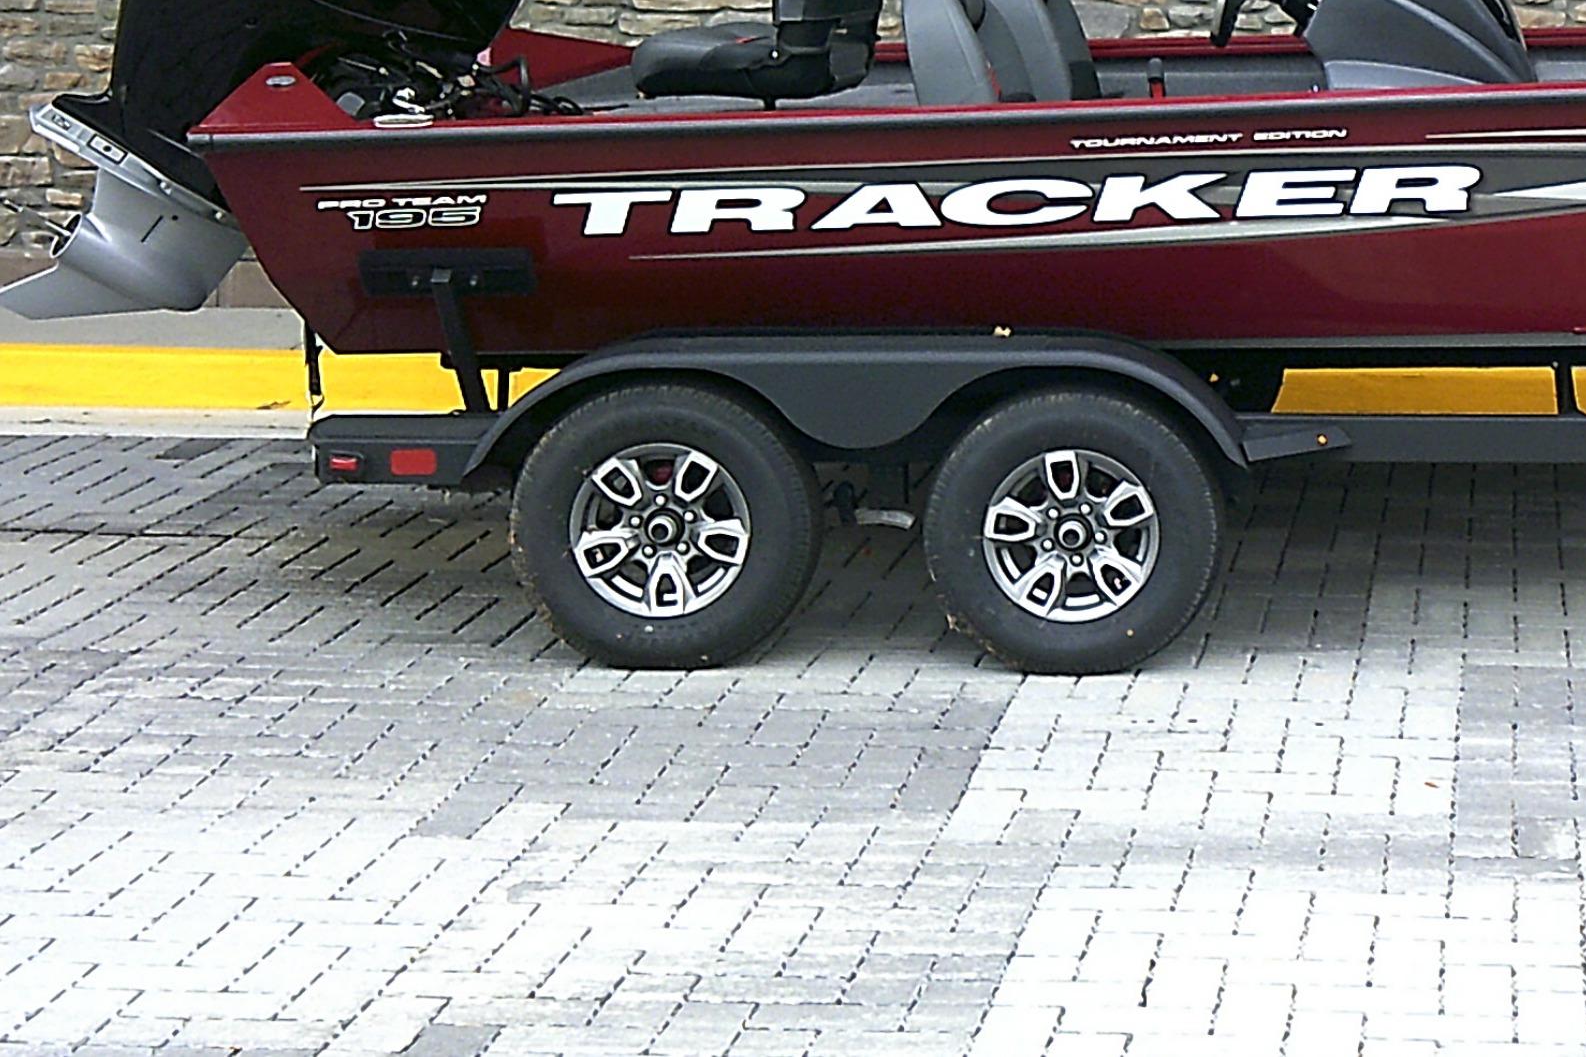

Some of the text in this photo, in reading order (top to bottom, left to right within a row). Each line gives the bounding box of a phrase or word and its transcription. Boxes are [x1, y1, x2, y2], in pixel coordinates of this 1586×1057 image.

[1070, 128, 1347, 149] TOURNAMENT EDITION
[317, 194, 488, 210] PRO TEAM
[553, 164, 1482, 236] TRACKER
[346, 205, 482, 230] 195
